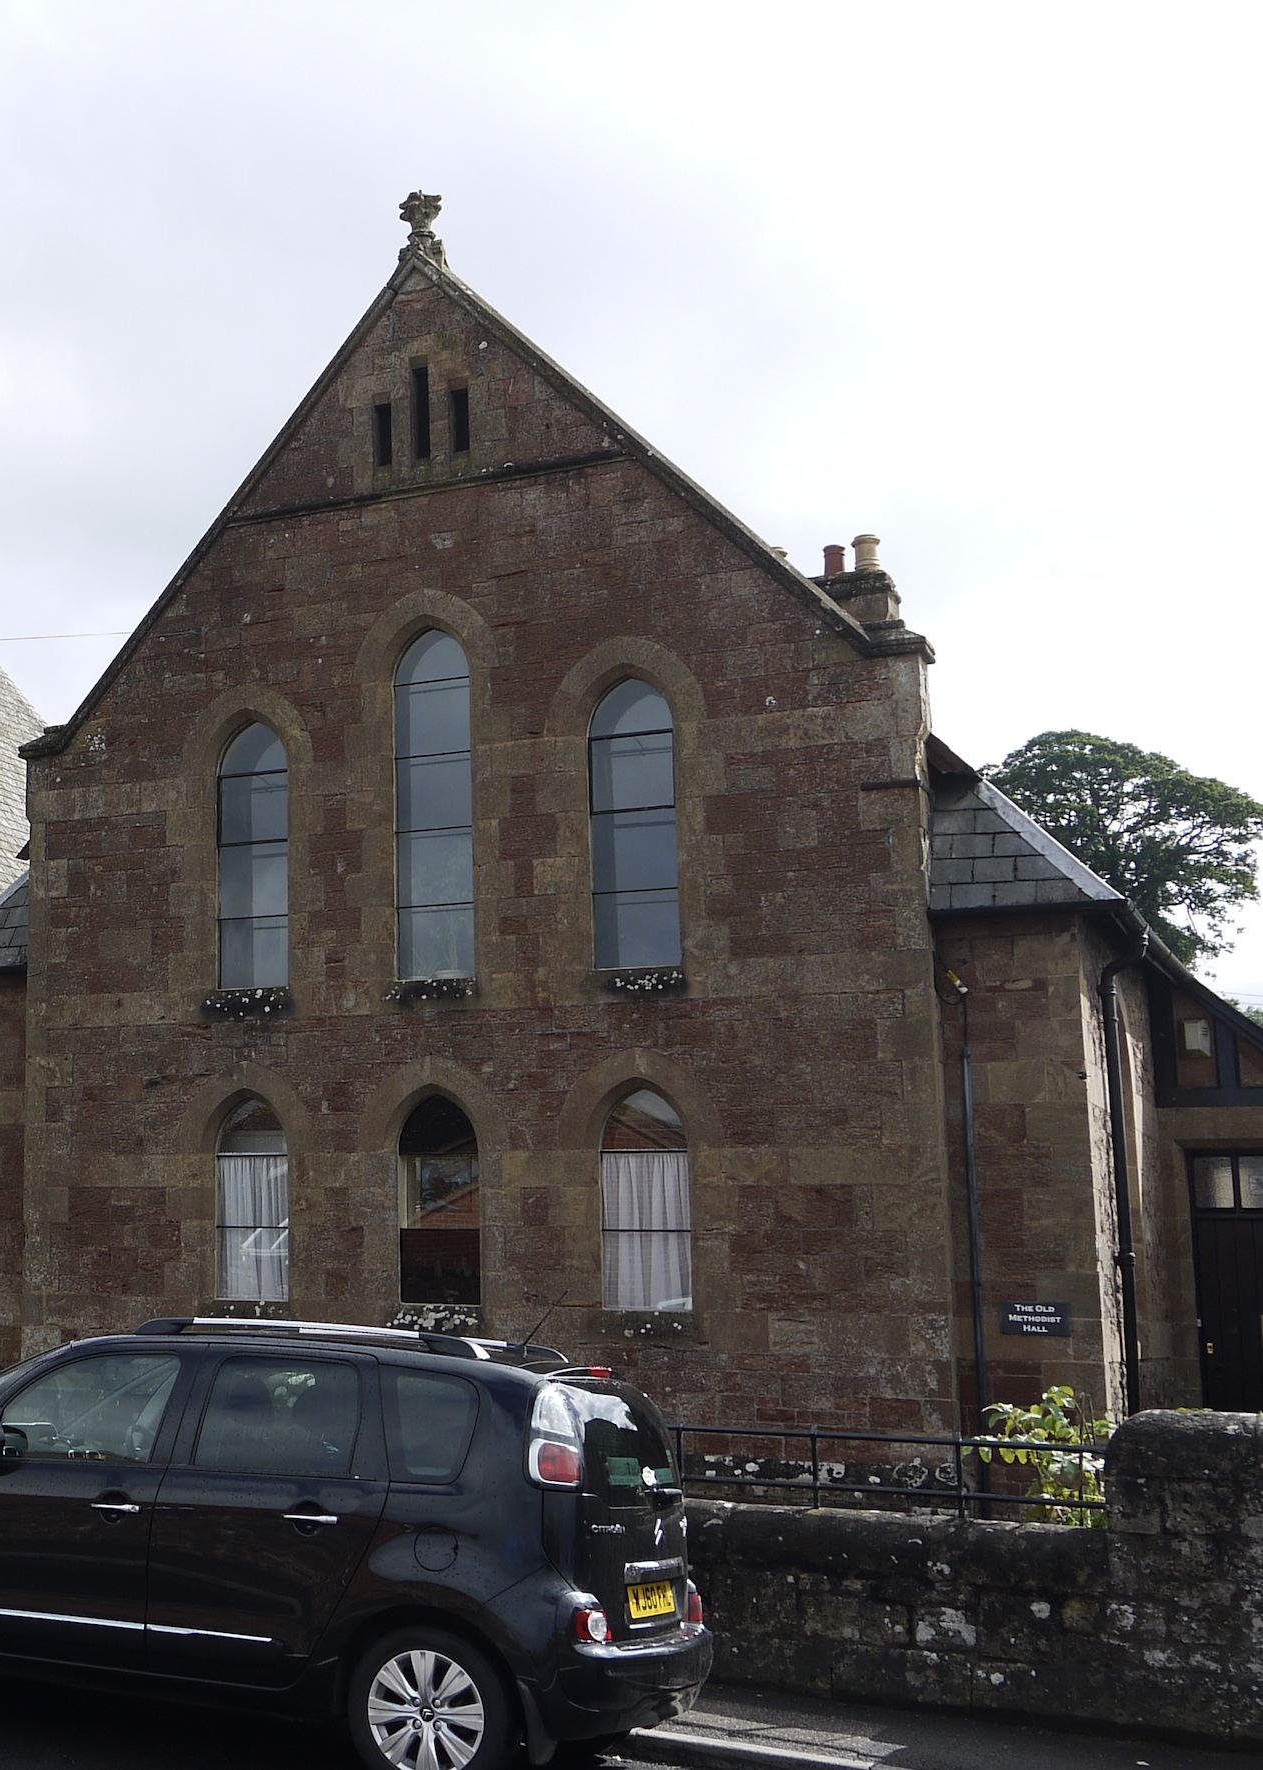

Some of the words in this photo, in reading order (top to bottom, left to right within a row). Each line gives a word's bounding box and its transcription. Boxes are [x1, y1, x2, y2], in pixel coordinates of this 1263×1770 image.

[1014, 1304, 1034, 1312] THE
[1035, 1305, 1055, 1313] OLD
[1008, 1314, 1062, 1323] METHODIST
[1022, 1324, 1048, 1333] HALL
